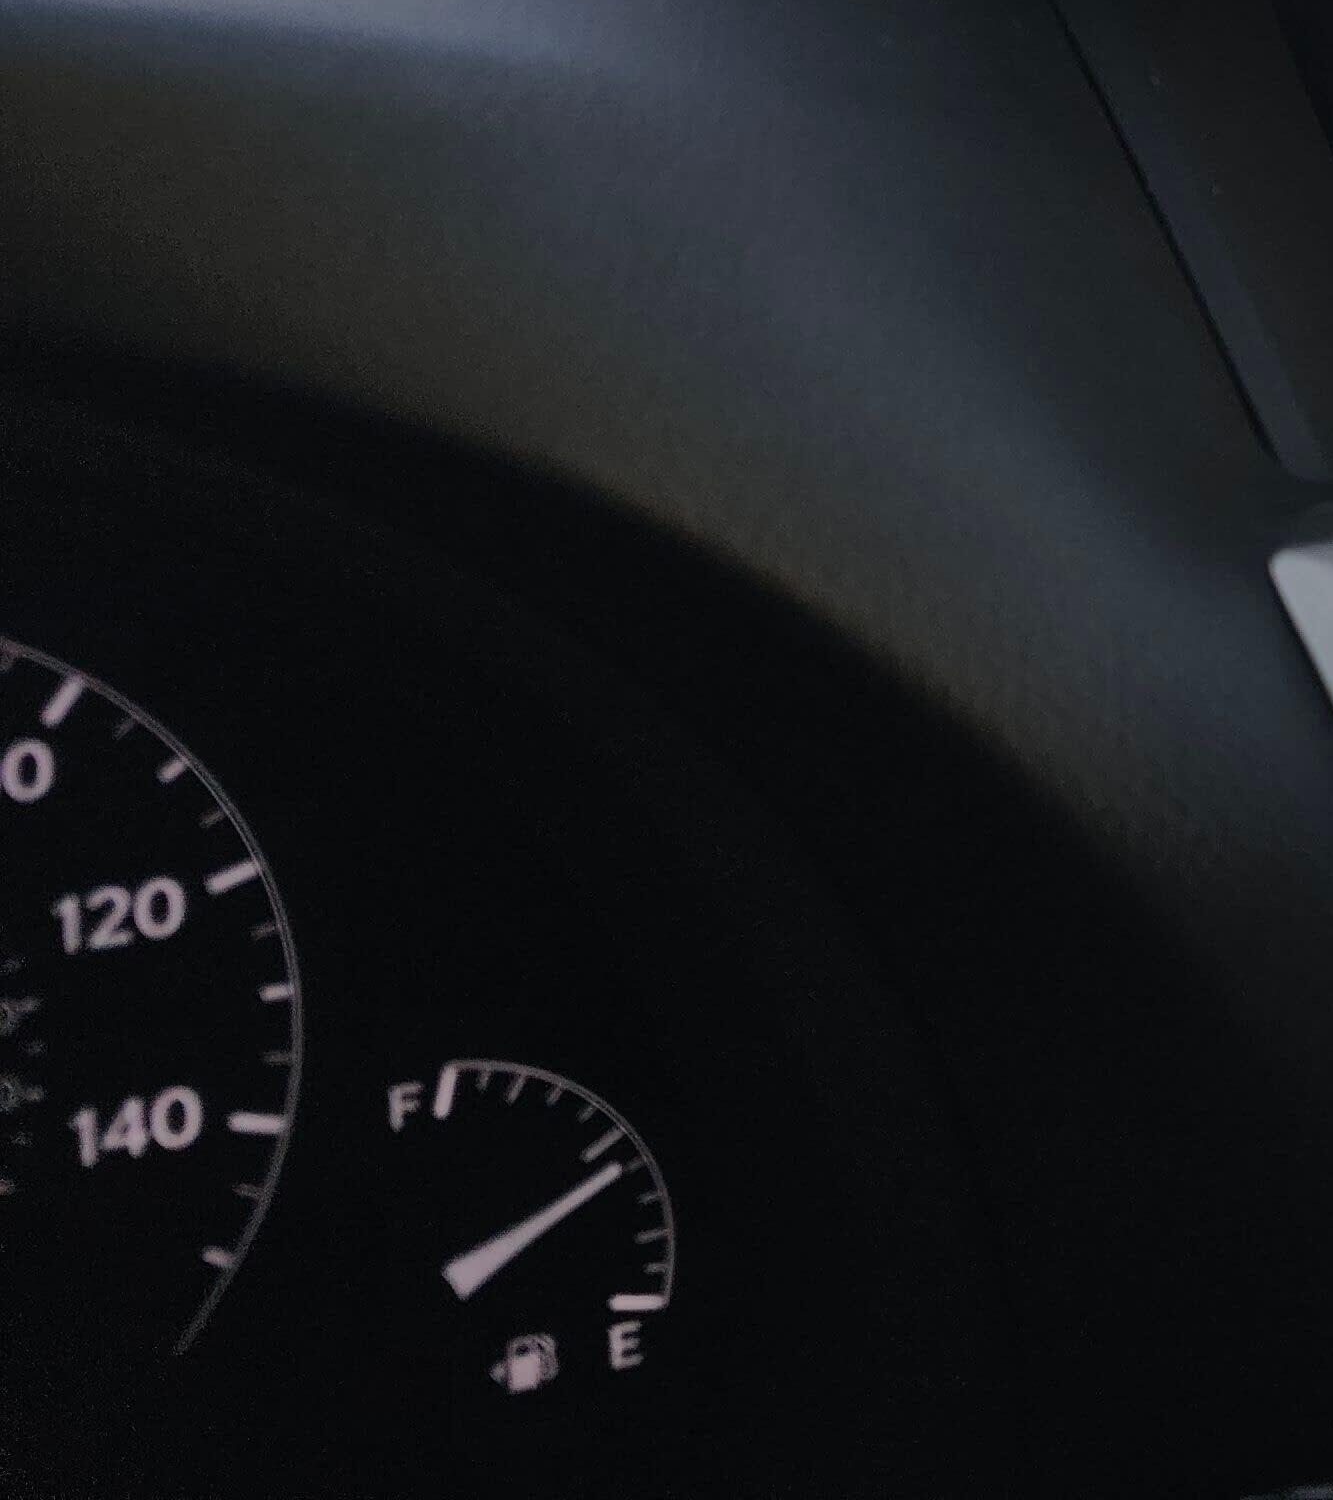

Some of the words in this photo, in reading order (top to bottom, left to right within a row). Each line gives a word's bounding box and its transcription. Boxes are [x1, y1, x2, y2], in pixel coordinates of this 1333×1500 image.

[52, 875, 187, 955] 120
[70, 1086, 205, 1168] 140
[388, 1082, 422, 1131] F
[609, 1324, 644, 1370] E
